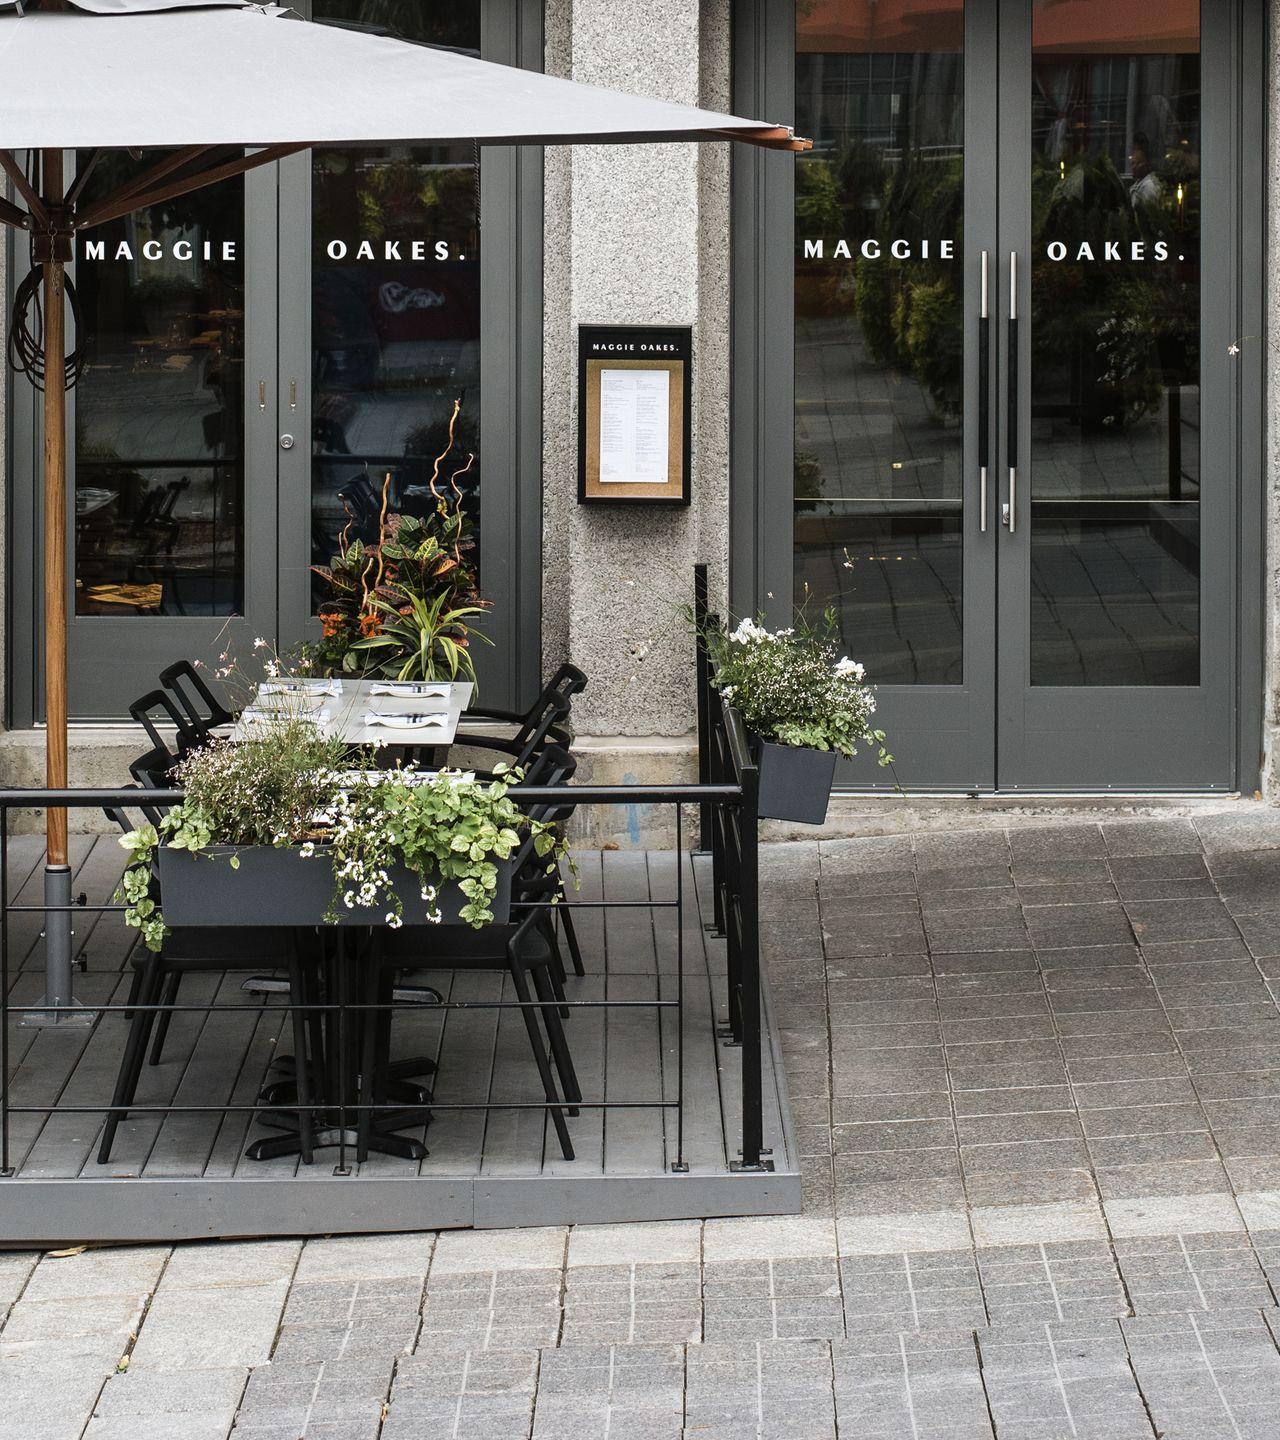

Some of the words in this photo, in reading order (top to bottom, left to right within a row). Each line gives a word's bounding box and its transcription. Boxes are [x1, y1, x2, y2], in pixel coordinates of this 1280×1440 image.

[85, 240, 236, 261] MAGGIE
[326, 239, 465, 261] OAKES.
[804, 239, 954, 260] MAGGIE
[1046, 241, 1185, 262] OAKES.
[592, 343, 635, 351] MAGGIE
[640, 343, 680, 352] OAKES.
